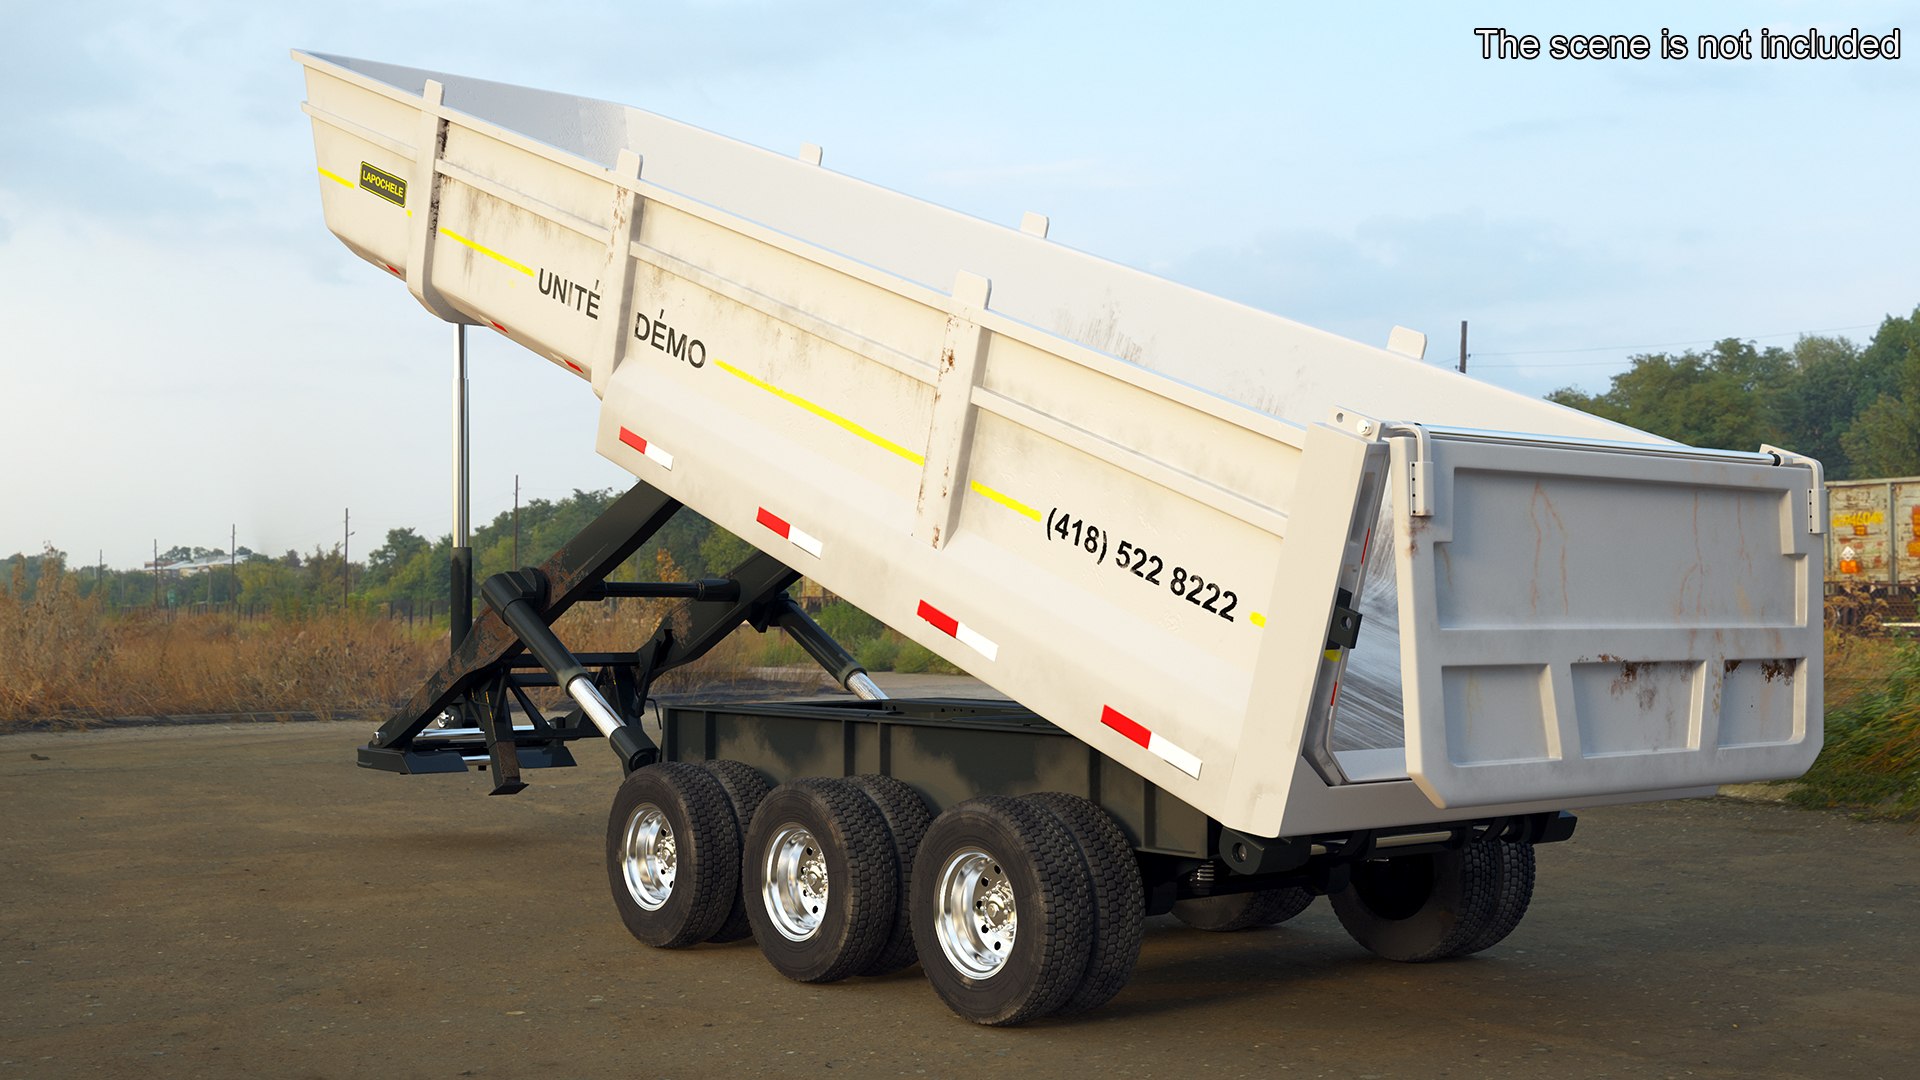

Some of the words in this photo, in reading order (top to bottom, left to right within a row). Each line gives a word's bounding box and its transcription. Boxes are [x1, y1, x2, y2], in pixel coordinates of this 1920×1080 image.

[362, 169, 404, 198] LAPOCHELE
[538, 267, 601, 320] UNITÉ
[634, 308, 707, 369] DÉMO
[1046, 507, 1108, 565] (418)
[1115, 540, 1164, 586] 522
[1170, 566, 1238, 622] 8222
